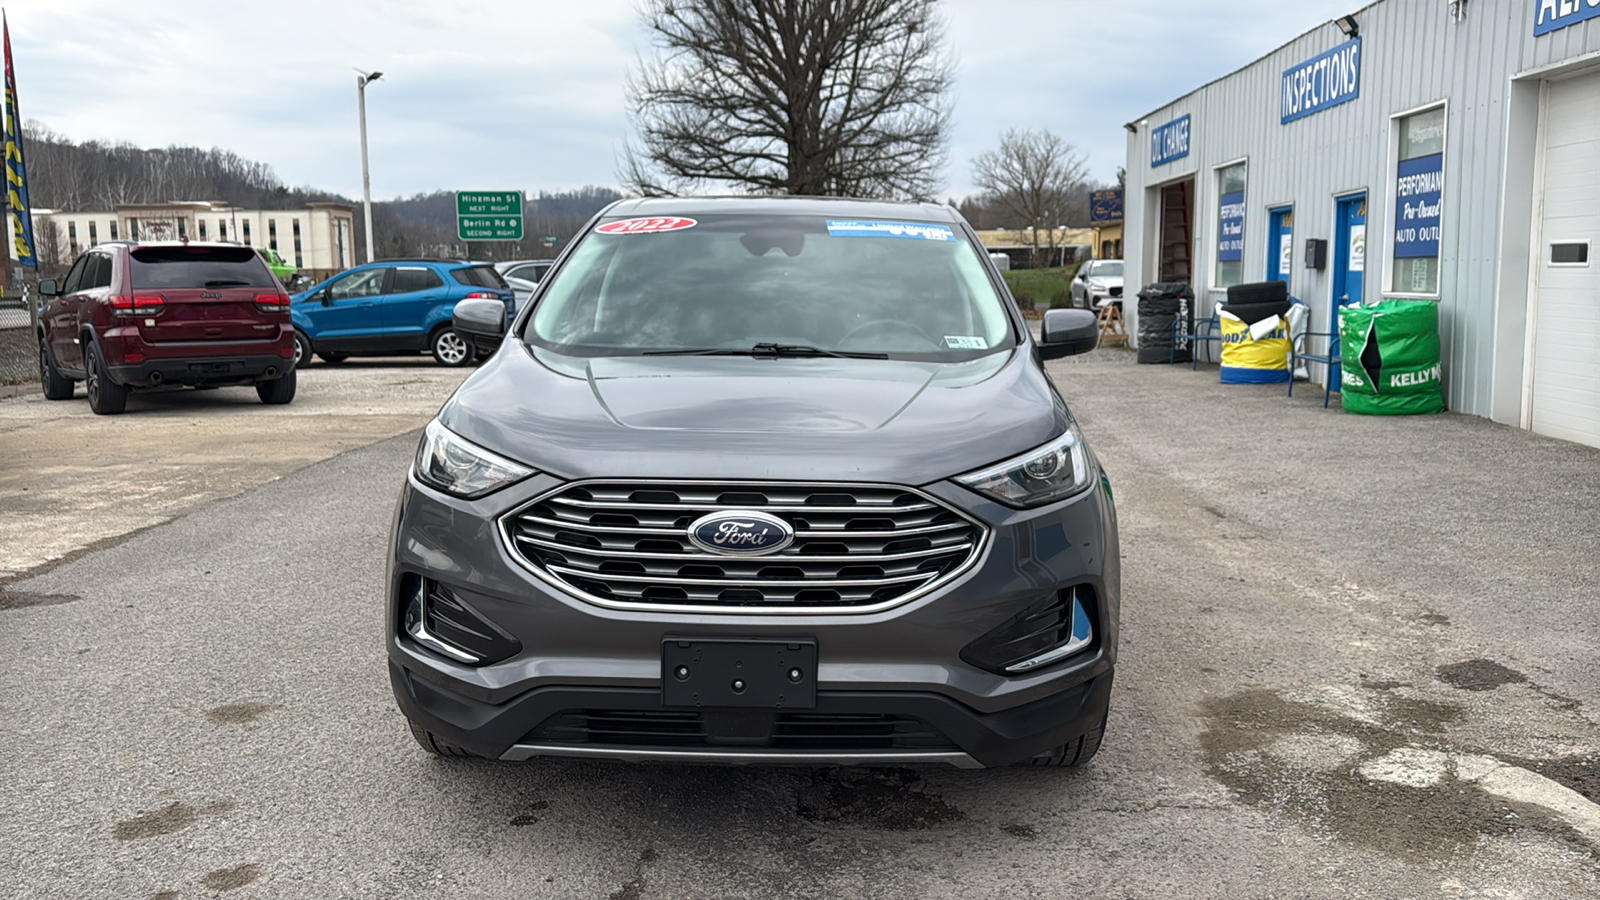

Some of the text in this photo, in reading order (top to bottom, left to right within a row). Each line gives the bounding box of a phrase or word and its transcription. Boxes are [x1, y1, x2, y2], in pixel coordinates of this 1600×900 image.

[1282, 44, 1357, 118] INSPECTIONS
[1152, 119, 1188, 163] OIL CHANGE
[462, 194, 516, 203] Hinzman St
[1403, 199, 1440, 220] Pre-Owned
[463, 219, 506, 227] Berlin Rd
[610, 217, 681, 232] 2022
[1396, 227, 1416, 243] AUTO
[200, 291, 222, 299] Jeep
[713, 521, 768, 545] Ford
